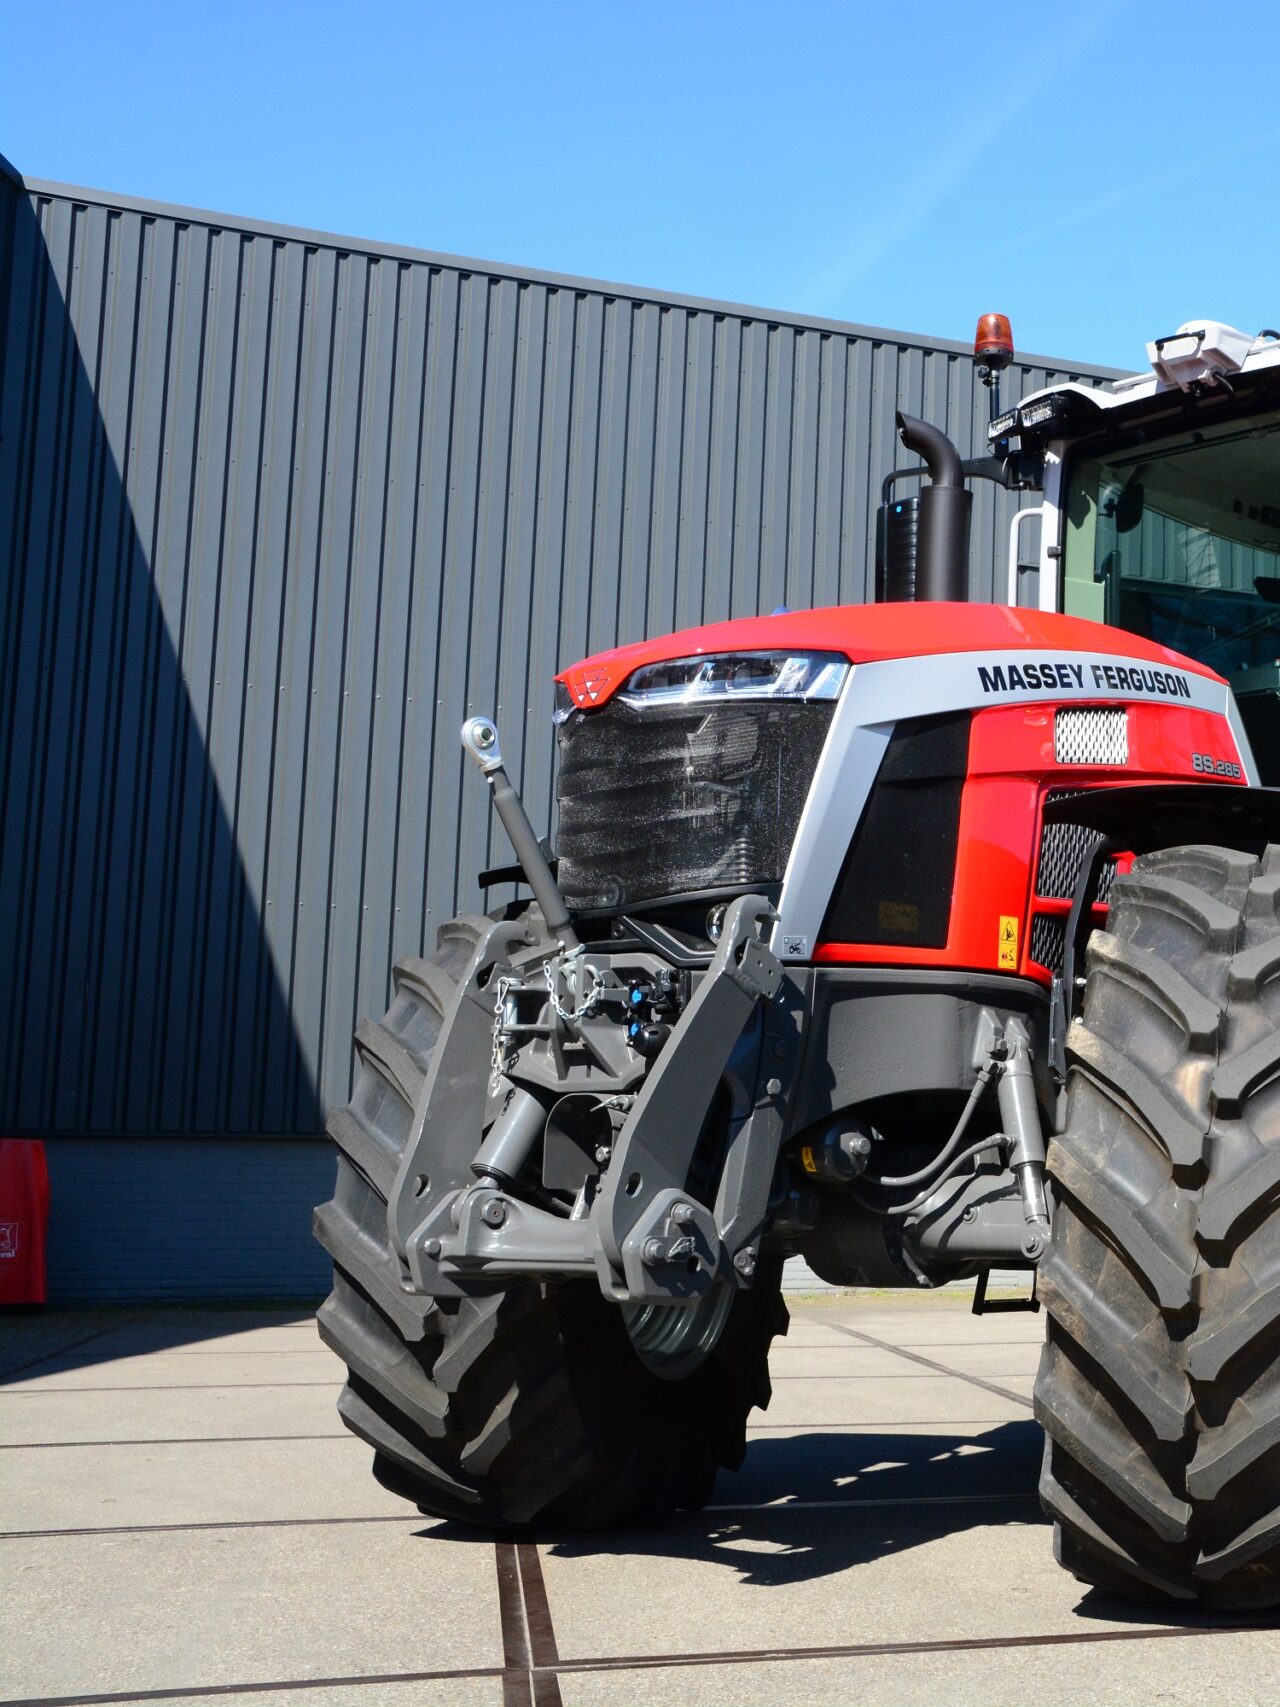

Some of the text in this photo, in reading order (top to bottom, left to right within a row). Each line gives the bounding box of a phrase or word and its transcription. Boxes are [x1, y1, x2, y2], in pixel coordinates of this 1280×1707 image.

[977, 663, 1192, 699] MASSEY FERGUSON
[1191, 752, 1241, 779] 8S.285
